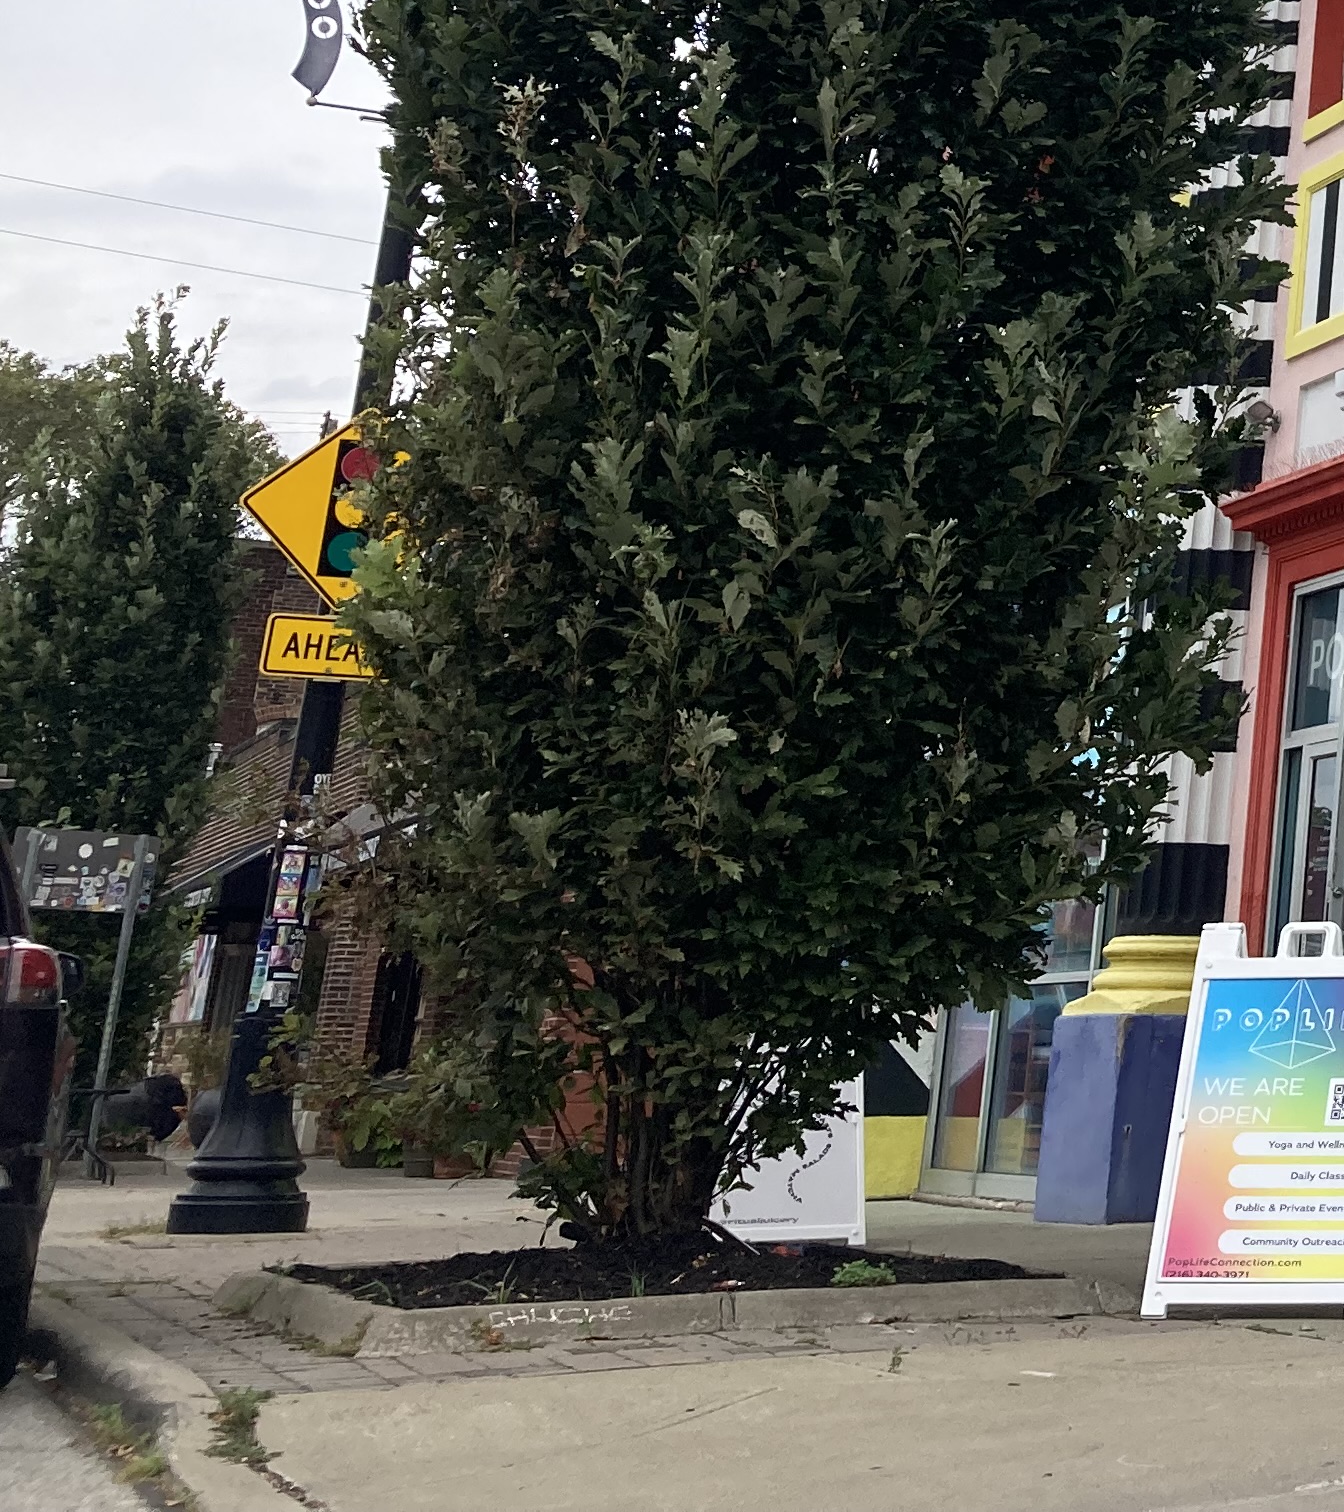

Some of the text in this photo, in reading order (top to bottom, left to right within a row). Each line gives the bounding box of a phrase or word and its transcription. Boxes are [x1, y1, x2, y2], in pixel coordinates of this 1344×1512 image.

[281, 631, 362, 663] AHEA
[1203, 1077, 1305, 1096] WE ARE
[1198, 1106, 1272, 1125] OPEN
[1268, 1140, 1293, 1151] Yoga
[1296, 1140, 1315, 1149] and
[1290, 1171, 1316, 1182] Daily
[1234, 1203, 1266, 1213] Public
[1268, 1203, 1276, 1213] &
[1279, 1203, 1316, 1213] Private
[1242, 1236, 1299, 1248] Community
[1167, 1257, 1302, 1267] PopLifeConnection.com
